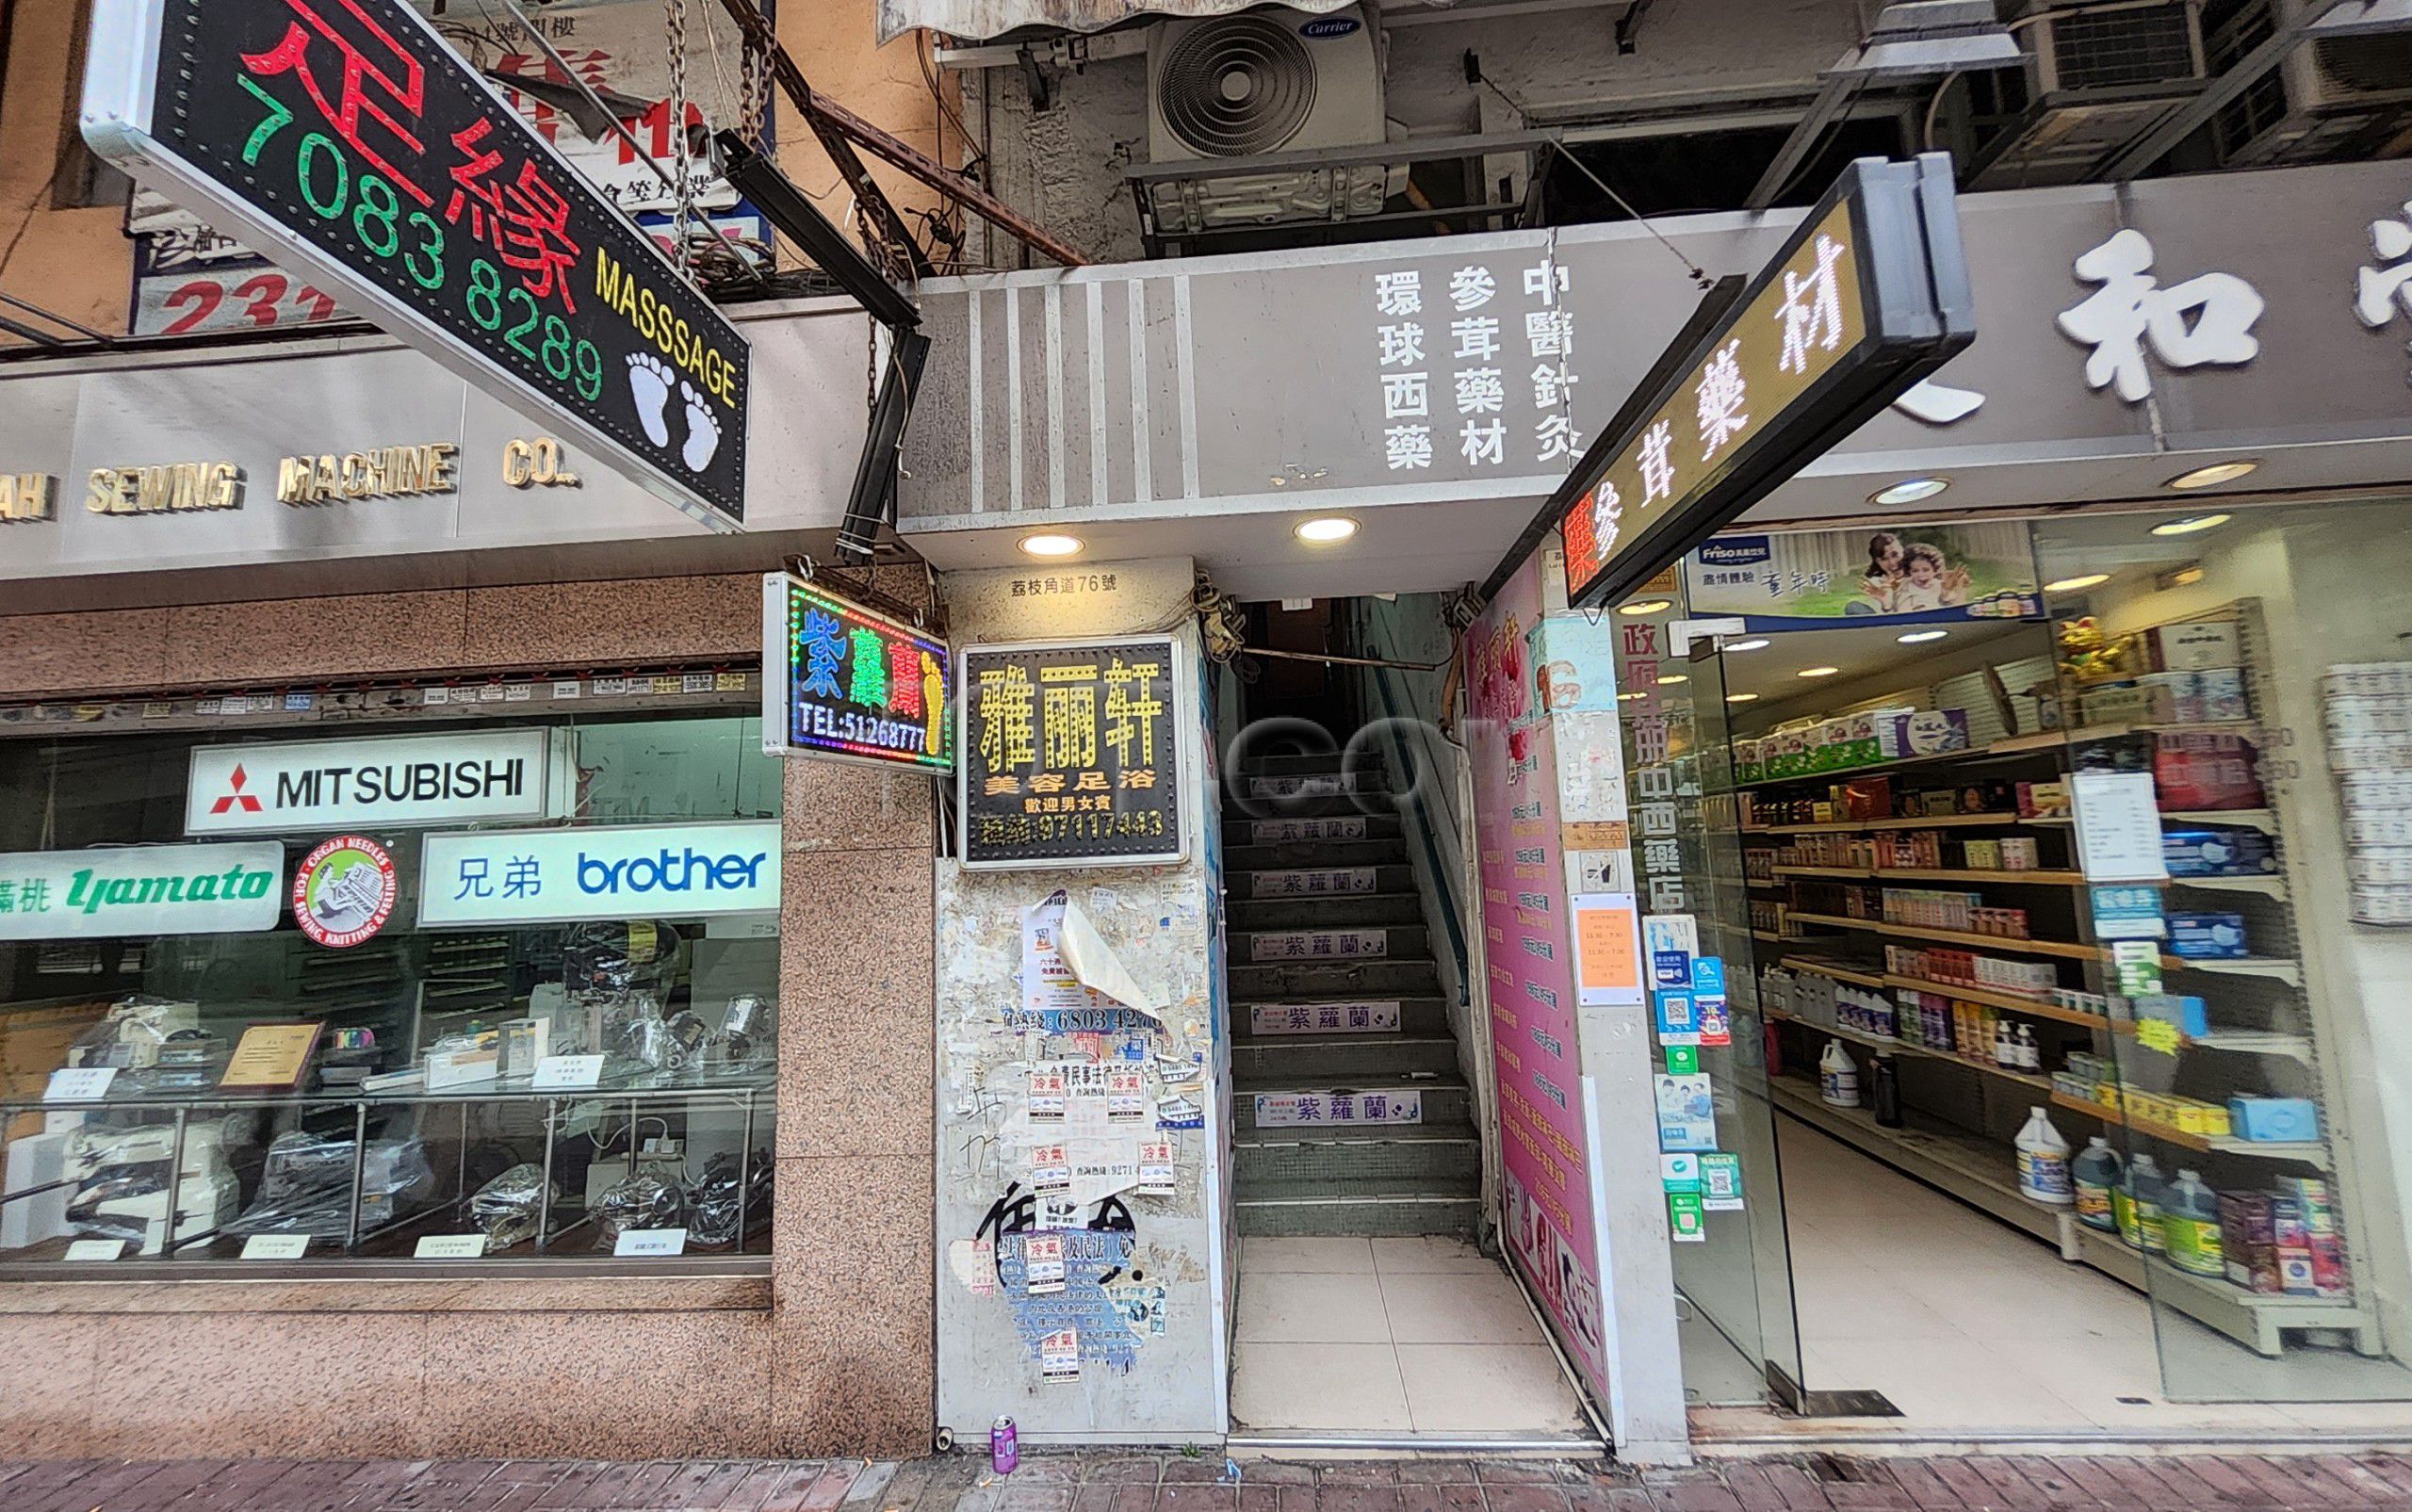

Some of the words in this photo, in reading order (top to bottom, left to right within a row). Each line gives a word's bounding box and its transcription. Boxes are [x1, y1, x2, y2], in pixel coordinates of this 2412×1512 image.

[1307, 20, 1354, 36] Carrier
[237, 73, 446, 289] 7083
[466, 258, 603, 402] 8289
[595, 246, 737, 408] MASSSAGE
[1375, 270, 1433, 469] 環球西藥
[1449, 266, 1508, 465] 參茸藥材
[1524, 260, 1586, 462] 中醫針灸
[87, 461, 246, 514] SEWING
[277, 443, 460, 507] MACHINE
[1703, 545, 1735, 559] Friso
[980, 658, 1163, 772] 雅丽轩
[275, 758, 524, 809] MITSUBISHI
[984, 769, 1157, 796] 美容足浴
[307, 838, 345, 868] ORGAN
[348, 837, 390, 867] NEEDLES
[455, 855, 544, 902] 兄弟
[577, 847, 767, 895] brother
[295, 872, 310, 898] FOR
[1057, 1010, 1106, 1031] 6803
[1288, 1006, 1370, 1029] 紫蘿蘭
[1296, 1095, 1387, 1121] 紫蘿蘭
